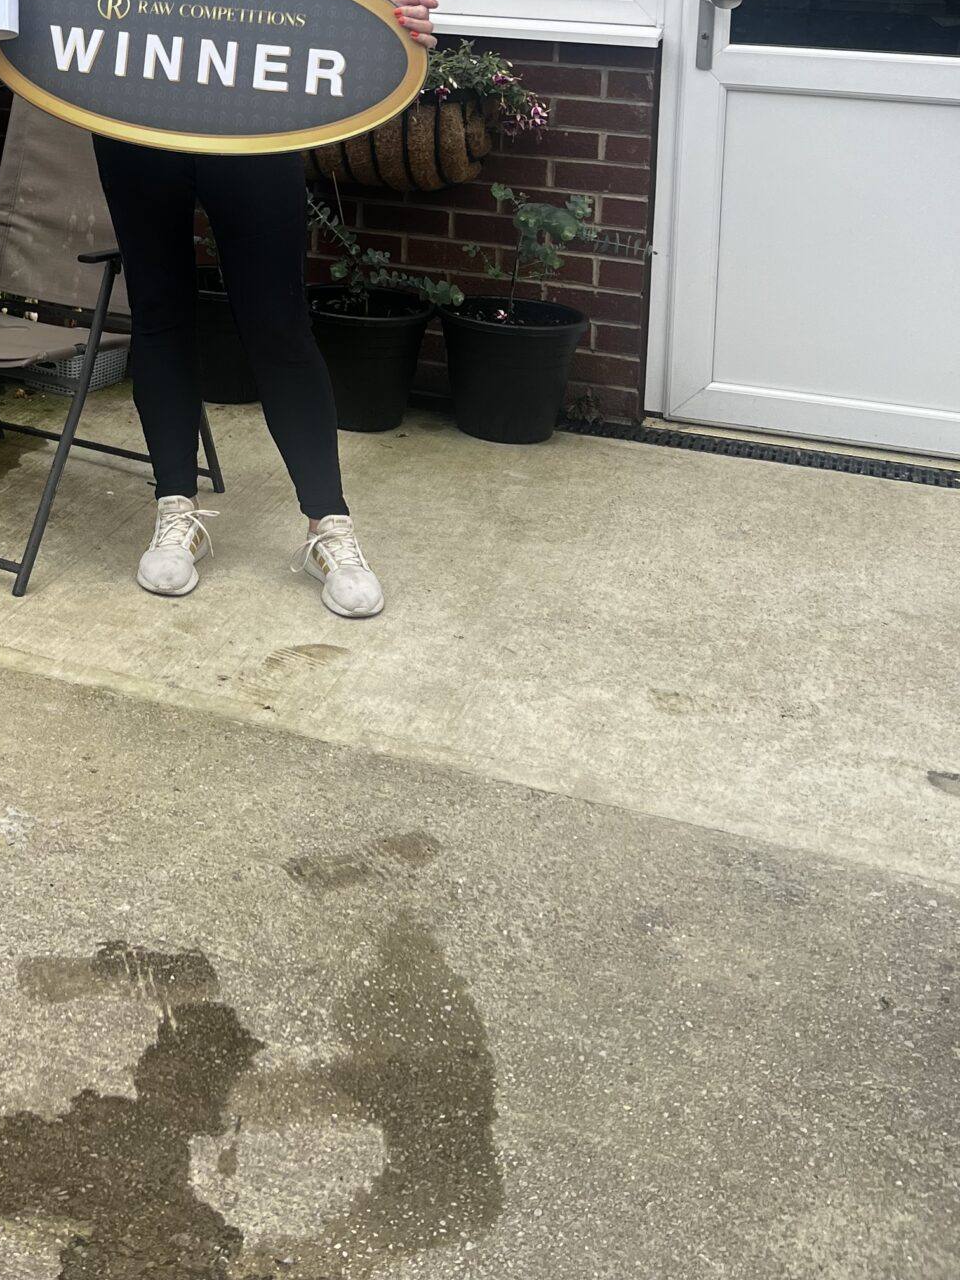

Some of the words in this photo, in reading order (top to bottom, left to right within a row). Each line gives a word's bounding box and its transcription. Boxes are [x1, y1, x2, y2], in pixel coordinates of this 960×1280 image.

[138, 0, 174, 16] RAW
[179, 3, 307, 27] COMPETITIONS
[50, 24, 346, 97] WINNER
